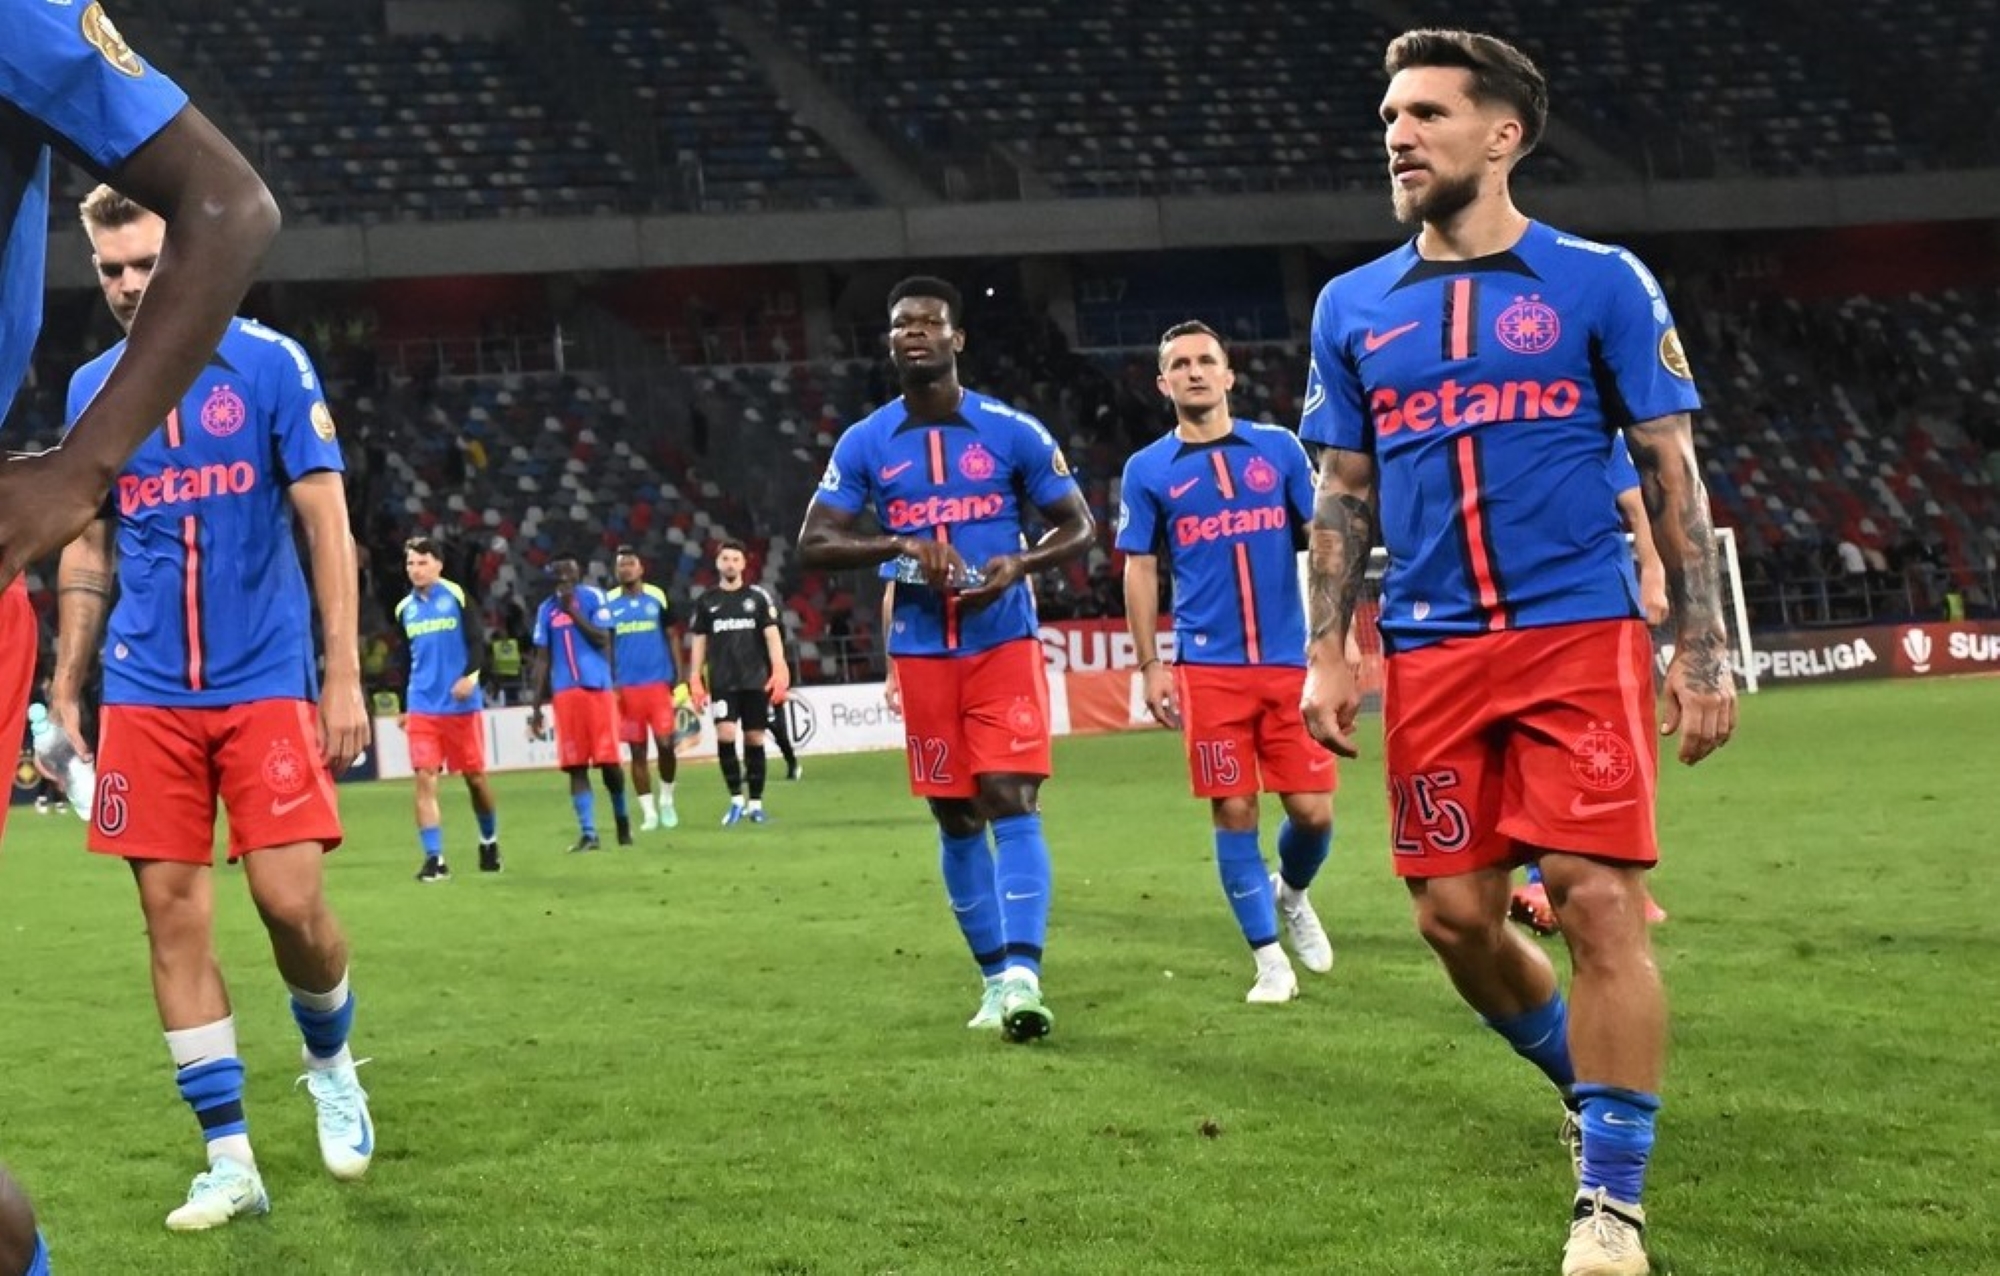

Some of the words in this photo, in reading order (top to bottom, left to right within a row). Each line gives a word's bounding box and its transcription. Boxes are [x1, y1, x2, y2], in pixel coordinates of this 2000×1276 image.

[1371, 379, 1581, 436] Betano
[117, 460, 255, 516] Betano
[888, 492, 1003, 527] Betano
[1175, 505, 1286, 546] Betano
[908, 735, 953, 784] 12
[1196, 740, 1240, 787] 15
[97, 772, 129, 837] 6
[1393, 770, 1470, 855] 25
